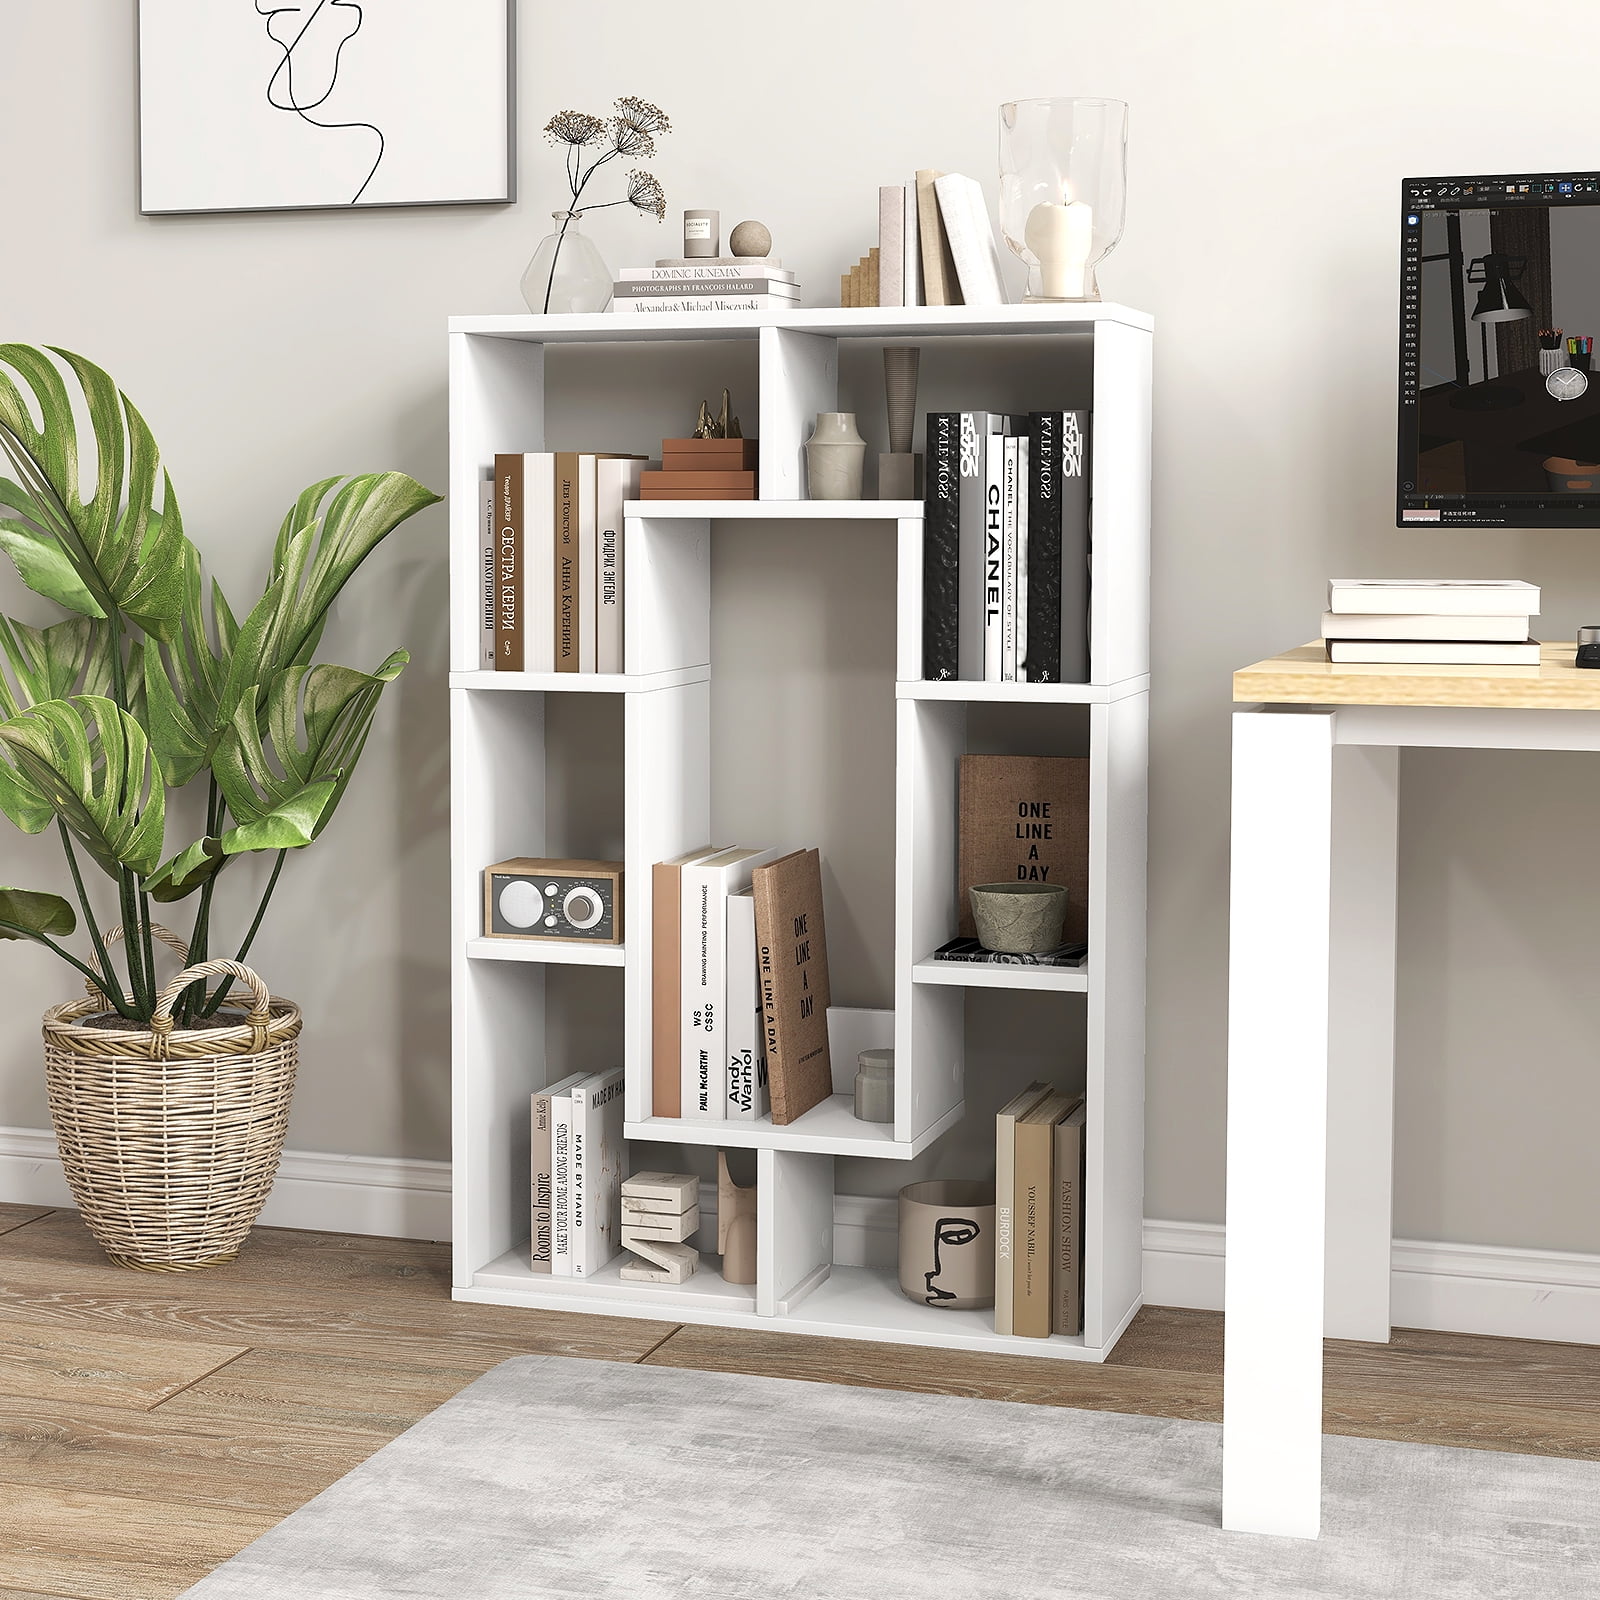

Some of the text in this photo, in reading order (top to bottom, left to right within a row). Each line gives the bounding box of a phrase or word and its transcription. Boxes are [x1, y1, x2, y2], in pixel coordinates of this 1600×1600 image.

[632, 283, 754, 293] PHOTOGRAPHS BY FRANÇOIS HALARD
[651, 267, 742, 280] DOMINIC KUNEMAN
[501, 526, 515, 582] СЕСТРА
[602, 530, 616, 605] ФРИДРИХ ЭНГЕЛЬС
[987, 484, 1000, 627] CHANEL
[484, 547, 494, 630] СТИХОТВОРЕНИЯ
[501, 585, 515, 630] КЕРРИ
[1006, 604, 1013, 618] OF
[1018, 802, 1052, 819] ONE
[1015, 823, 1053, 840] LINE
[1028, 844, 1039, 861] A
[1017, 864, 1050, 882] DAY
[794, 913, 808, 939] ONE
[796, 940, 812, 967] LINE
[802, 970, 809, 990] A
[704, 1003, 714, 1032] CSSC
[761, 946, 778, 1055] ONE LINE A DAY
[800, 999, 814, 1020] DAY
[693, 1010, 702, 1027] WS
[592, 1088, 606, 1110] MADE
[608, 1083, 615, 1102] BY
[699, 1049, 710, 1112] PAUL McCARTHY
[728, 1055, 744, 1104] Andy
[740, 1048, 752, 1113] Warhol
[536, 1098, 548, 1132] Annie Kelly
[556, 1123, 568, 1255] MAKE YOUR HOME AMONG FRIENDS
[575, 1134, 583, 1228] MADE BY HAND
[532, 1172, 552, 1262] Rooms to Inspire
[1027, 1186, 1036, 1228] YOUSSEF
[1000, 1207, 1010, 1260] BURDOCK
[1027, 1229, 1036, 1258] NABIL
[1061, 1180, 1072, 1273] FASHION SHOW
